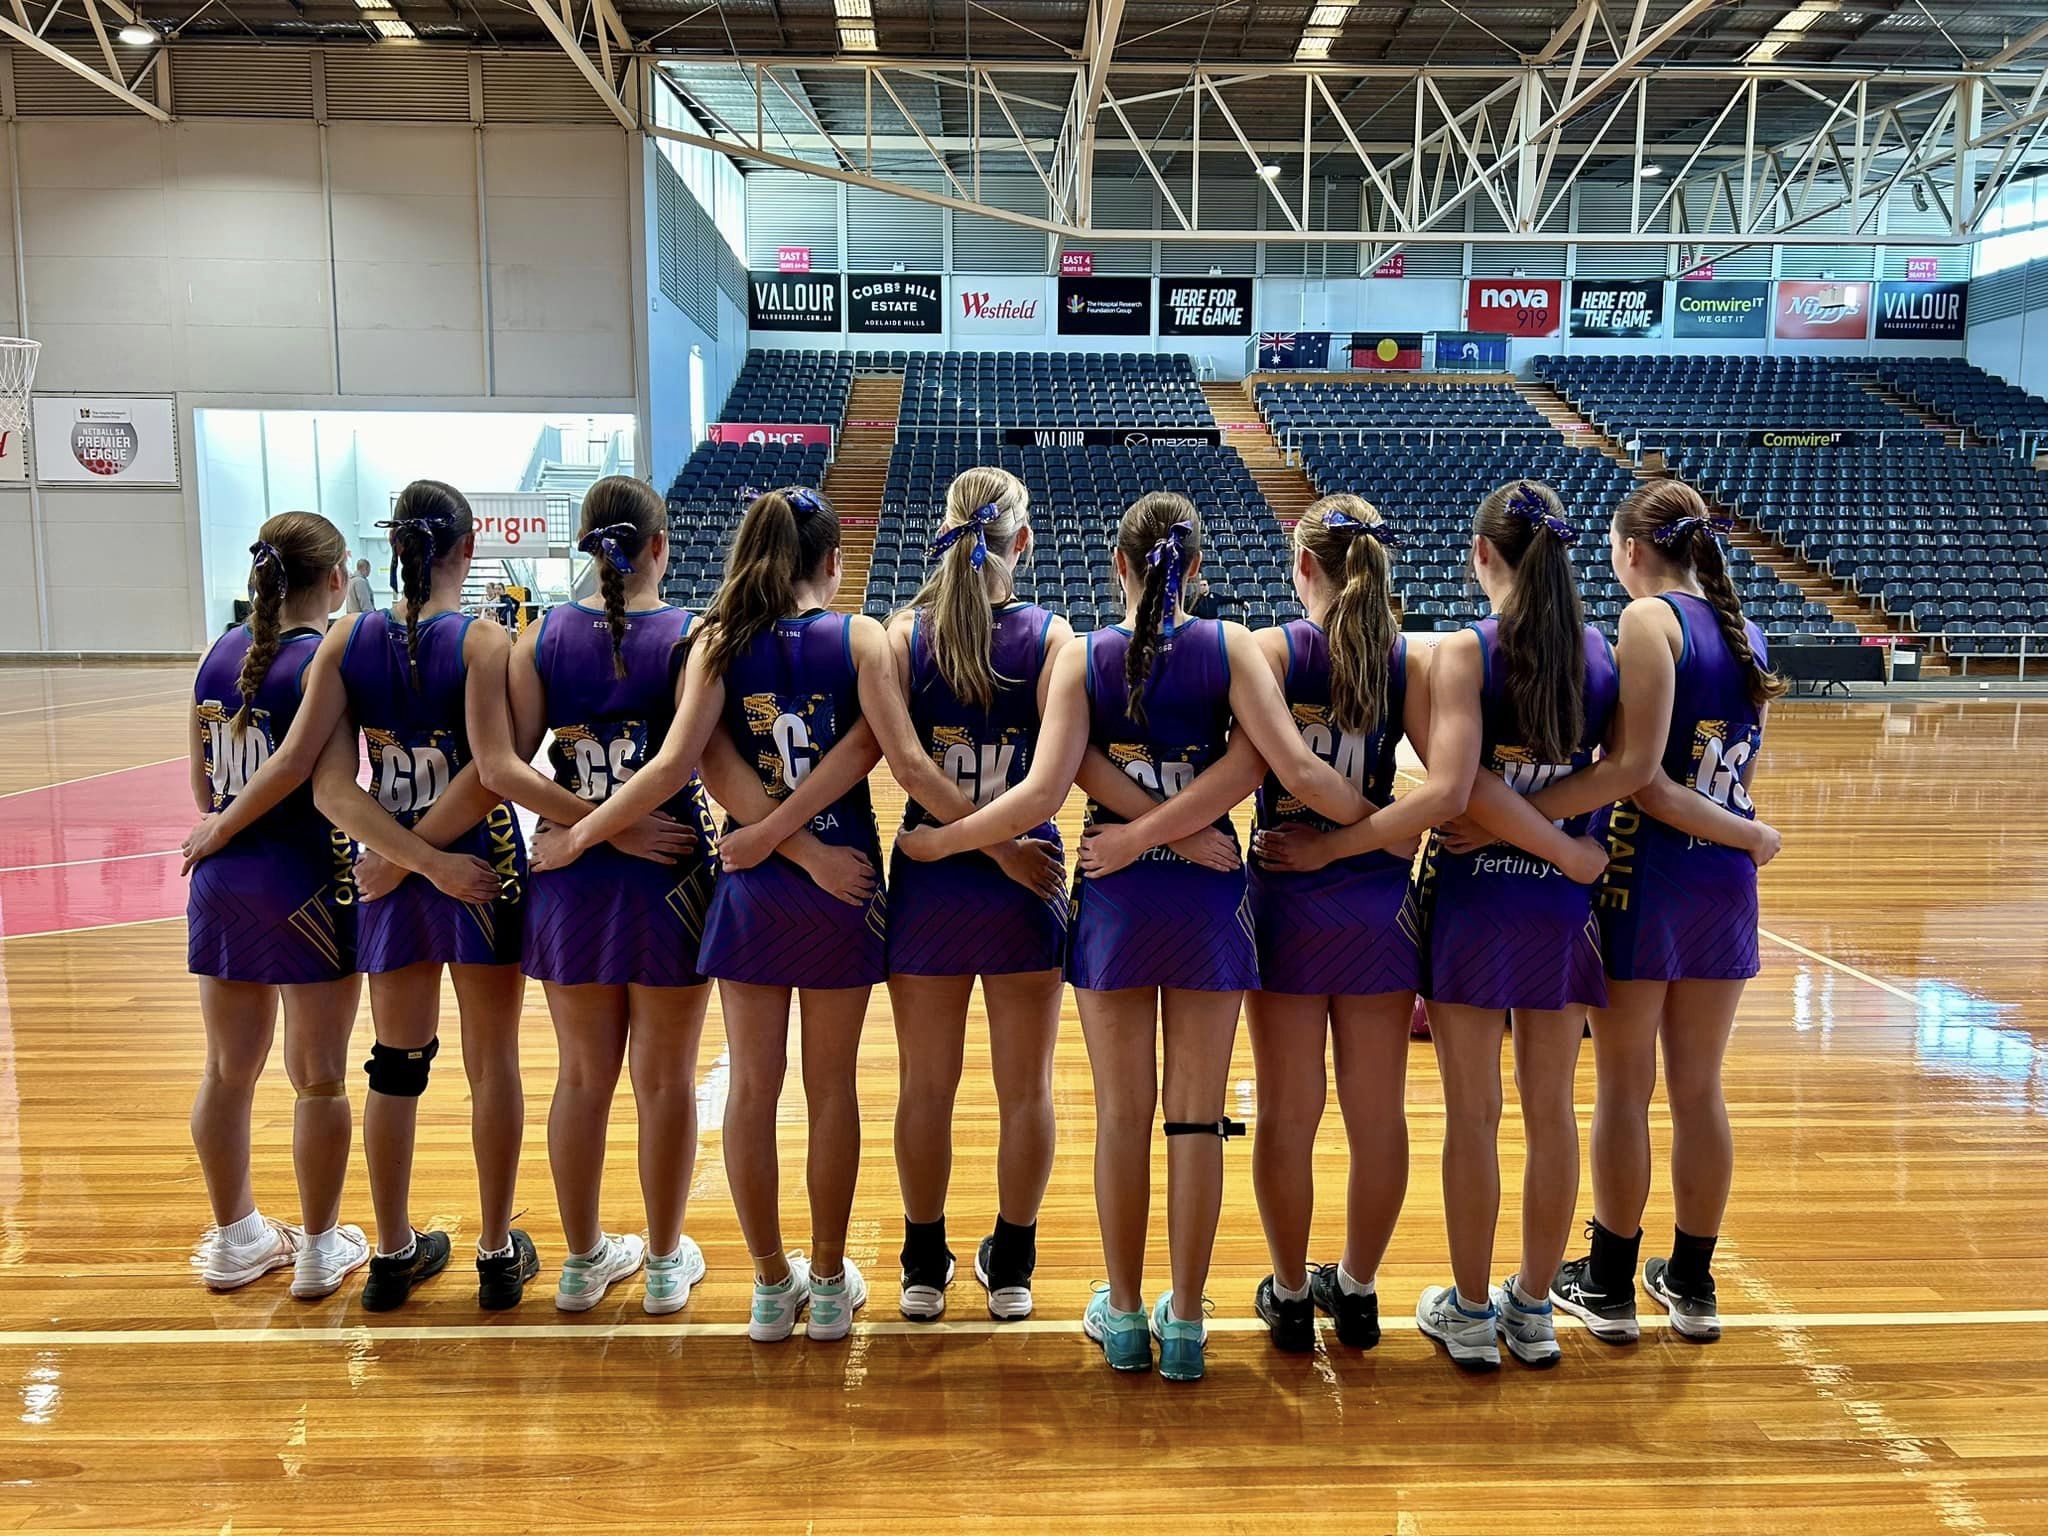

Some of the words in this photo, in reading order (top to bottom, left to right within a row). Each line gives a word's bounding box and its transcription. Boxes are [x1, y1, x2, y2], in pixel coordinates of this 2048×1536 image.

[780, 251, 800, 261] EAST
[1063, 256, 1083, 265] EAST
[1084, 256, 1090, 265] 4
[1396, 258, 1402, 267] 3
[1909, 262, 1929, 271] EAST
[755, 282, 834, 312] VALOUR
[905, 283, 937, 301] HILL
[1170, 288, 1207, 307] HERE
[1208, 288, 1237, 307] FOR
[1481, 288, 1549, 309] nova
[1580, 291, 1618, 309] HERE
[1617, 291, 1647, 309] FOR
[871, 301, 918, 312] ESTATE
[960, 292, 1039, 319] Westfield
[1884, 292, 1960, 320] VALOUR
[864, 319, 902, 327] ADELAIDE
[1174, 307, 1201, 326] THE
[1202, 307, 1244, 326] GAME
[1517, 309, 1548, 329] 919
[1584, 309, 1611, 328] THE
[1611, 309, 1653, 328] GAME
[1698, 315, 1712, 323] WE
[1714, 315, 1733, 323] GET
[1735, 315, 1744, 323] IT
[78, 436, 131, 448] PREMIER
[83, 448, 127, 460] LEAGUE
[208, 721, 269, 796] WD
[772, 713, 812, 791] C
[378, 744, 450, 813] GD
[575, 738, 638, 801] GS
[1696, 736, 1755, 811] GS
[486, 803, 522, 905] OAKD
[1600, 801, 1641, 911] DALE
[331, 827, 354, 905] OAKD
